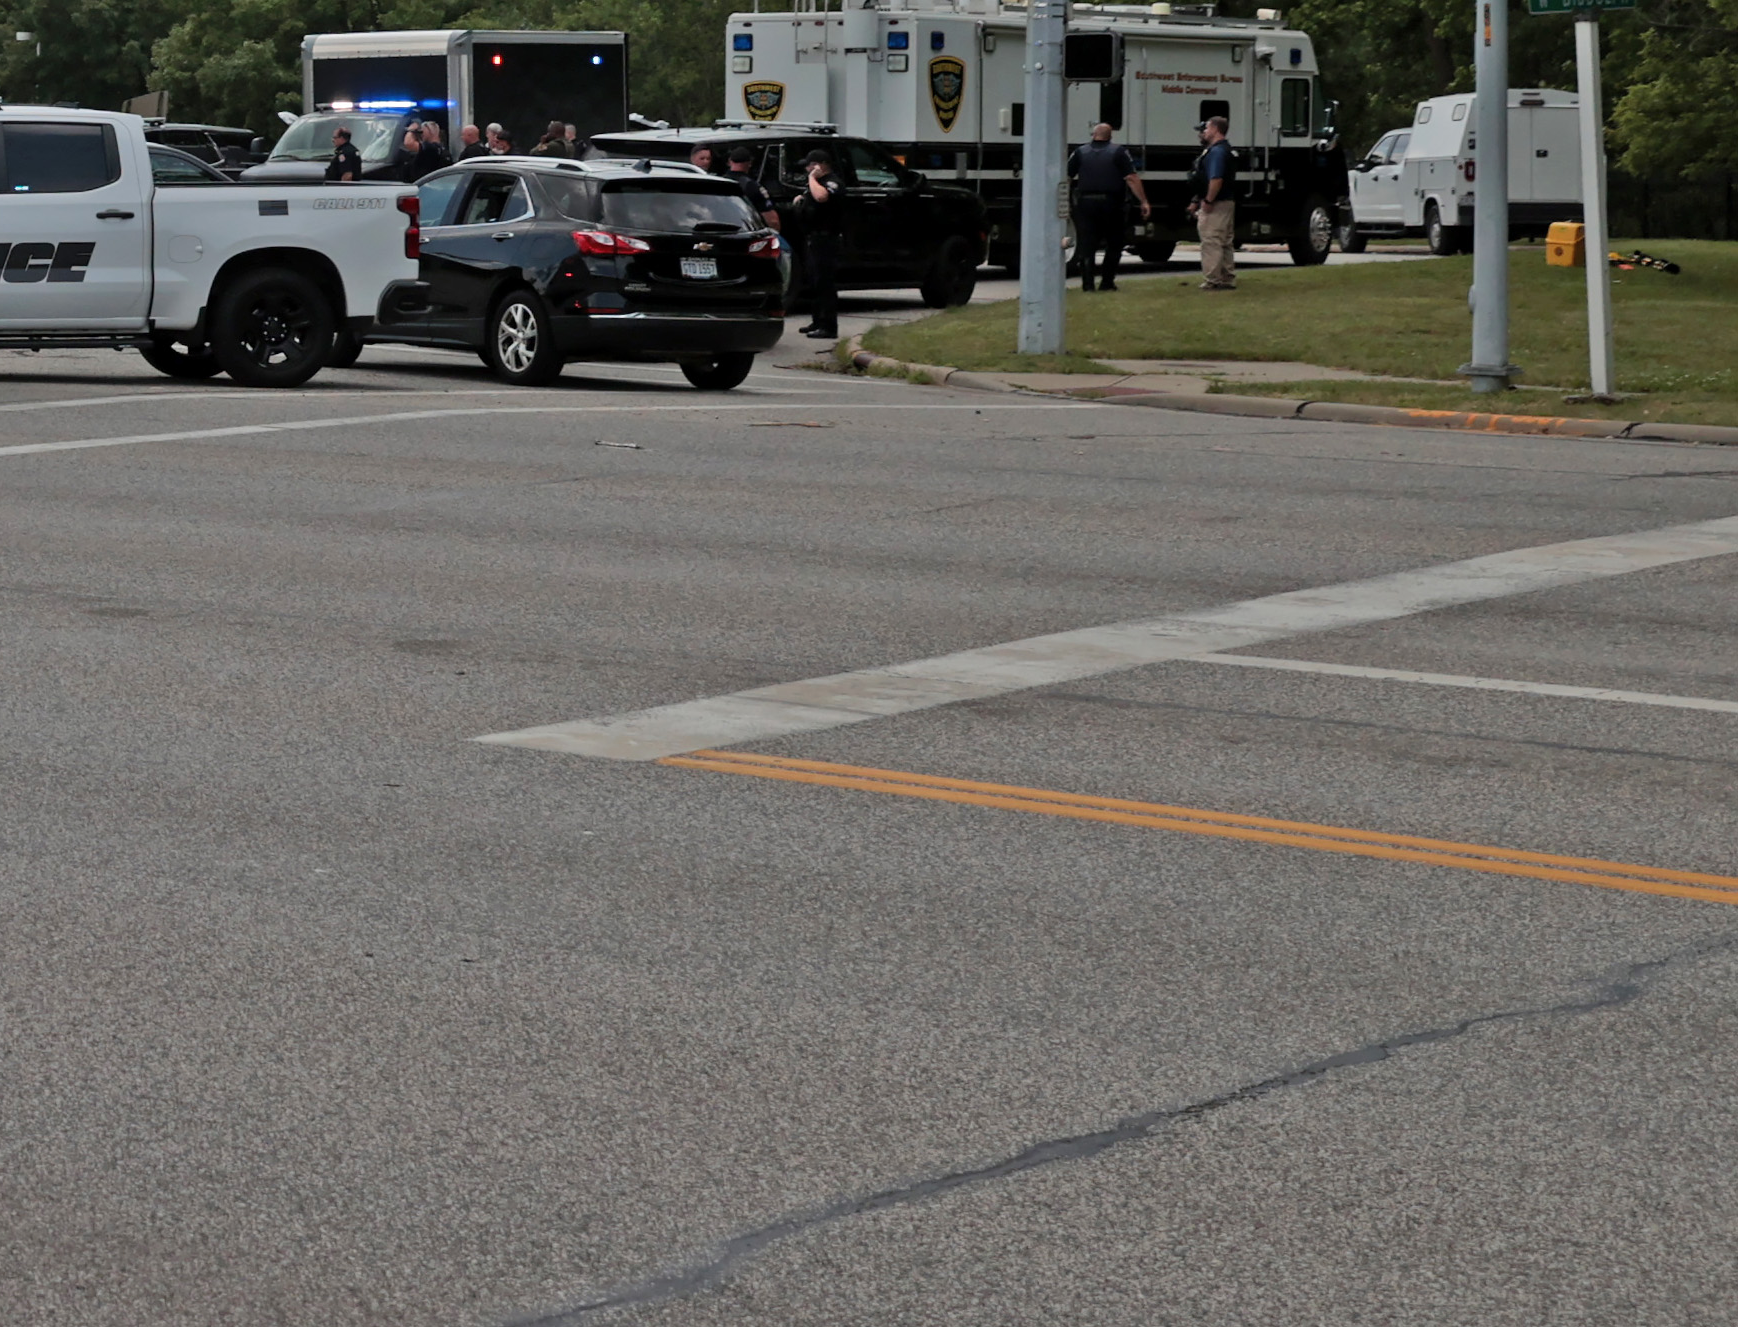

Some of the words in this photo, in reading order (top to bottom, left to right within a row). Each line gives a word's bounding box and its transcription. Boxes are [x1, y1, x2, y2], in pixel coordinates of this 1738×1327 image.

[1162, 84, 1183, 93] Mobile
[1185, 85, 1217, 95] Command
[313, 197, 355, 210] CALL
[356, 197, 387, 210] 911
